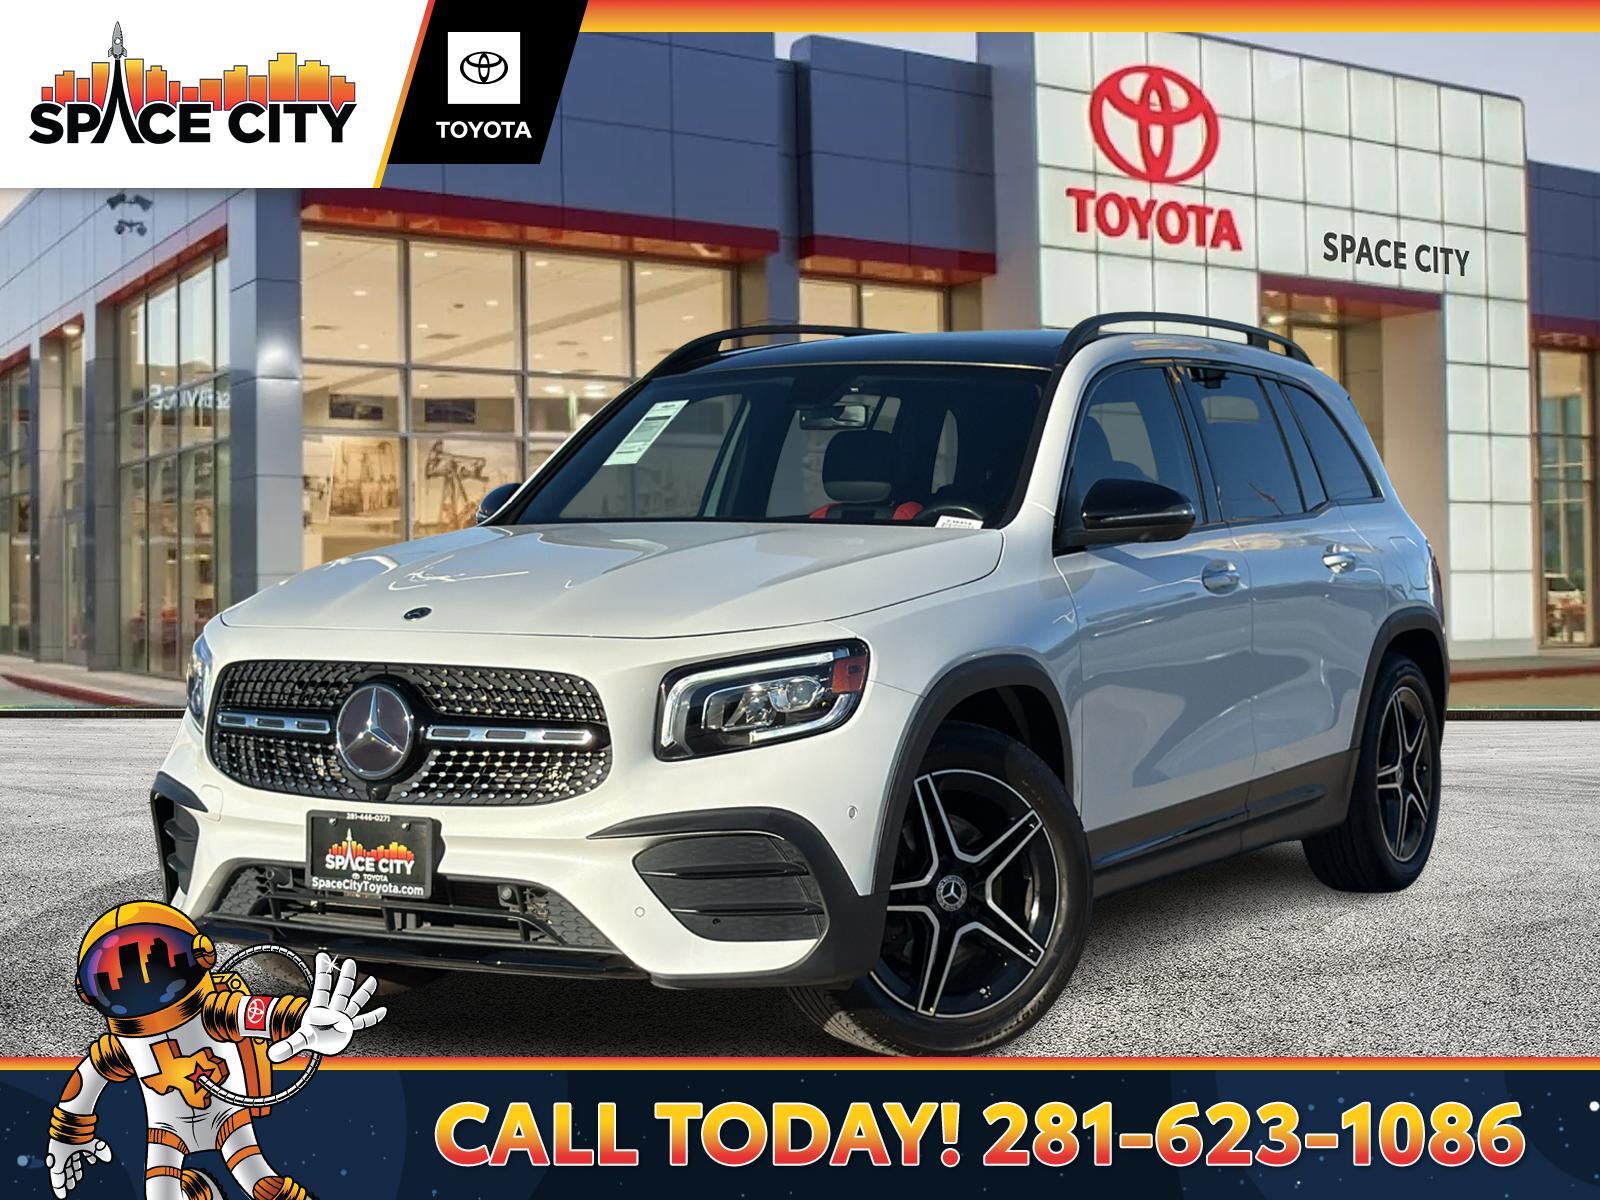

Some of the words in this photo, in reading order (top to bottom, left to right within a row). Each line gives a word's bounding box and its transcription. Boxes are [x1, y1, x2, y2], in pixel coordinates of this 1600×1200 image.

[1066, 187, 1243, 252] TOYOTA
[1323, 231, 1407, 271] SPACE
[1414, 244, 1471, 278] CITY
[325, 852, 375, 872] SPACE
[378, 858, 414, 875] CITY
[311, 876, 424, 895] SpaceCityToyota.com
[363, 873, 388, 882] TOYOTA
